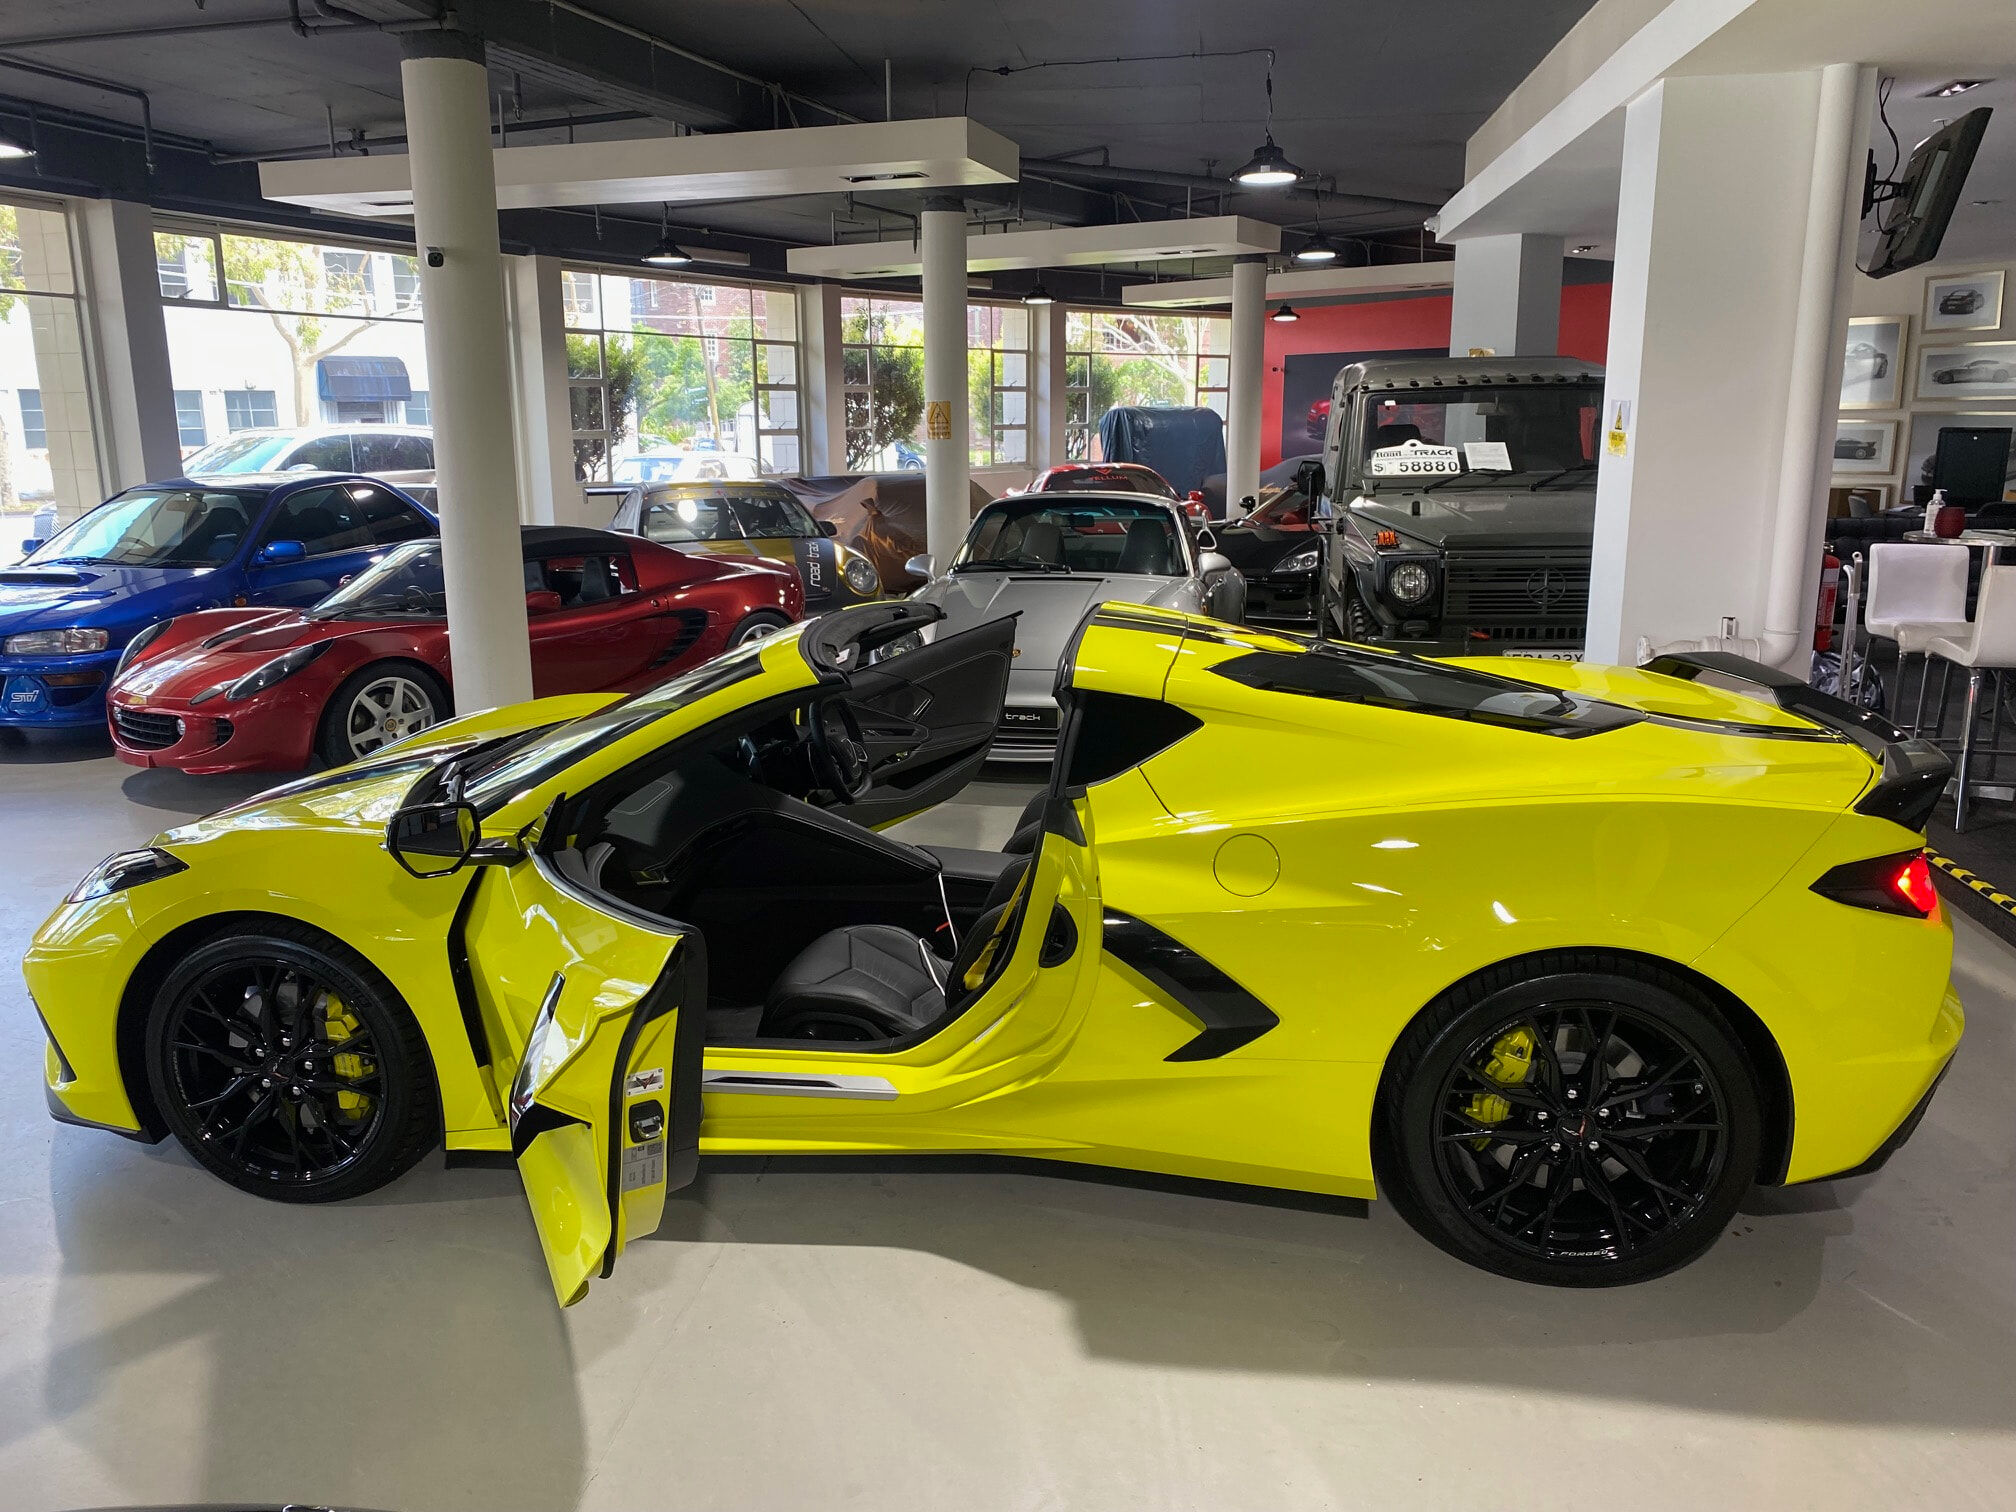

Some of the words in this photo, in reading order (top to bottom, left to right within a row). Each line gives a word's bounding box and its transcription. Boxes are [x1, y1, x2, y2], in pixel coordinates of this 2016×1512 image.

[1373, 463, 1384, 473] $
[1399, 461, 1458, 473] 58880
[1005, 713, 1041, 721] track
[1560, 1249, 1609, 1257] FORGED
